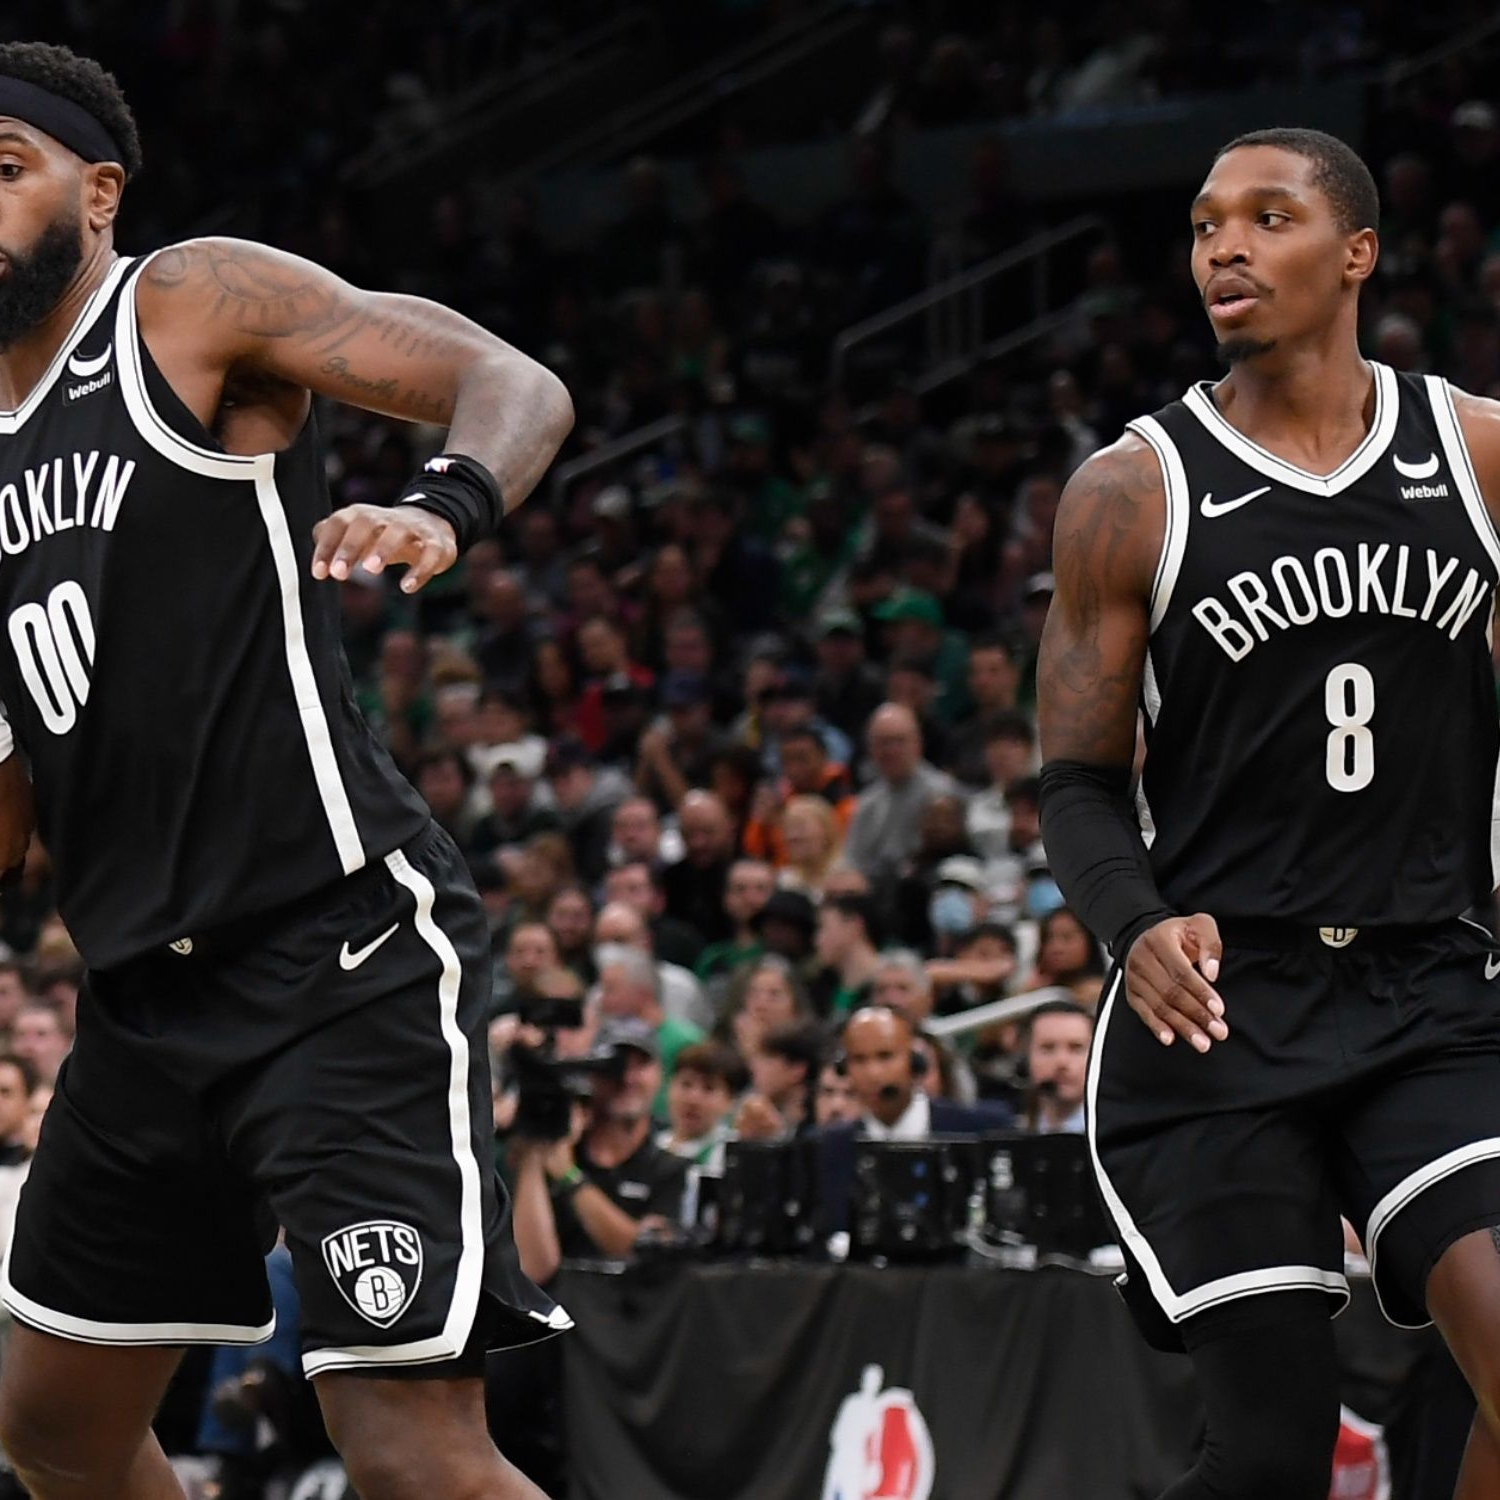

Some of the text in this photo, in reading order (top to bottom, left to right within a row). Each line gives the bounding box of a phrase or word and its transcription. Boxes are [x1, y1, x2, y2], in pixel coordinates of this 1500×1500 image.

[68, 371, 111, 400] Webull
[1400, 484, 1449, 500] Webull
[1191, 543, 1489, 663] BROOKLYN
[8, 580, 97, 736] 00
[1325, 662, 1375, 792] 8
[329, 1225, 419, 1279] NETS
[370, 1274, 390, 1312] B
